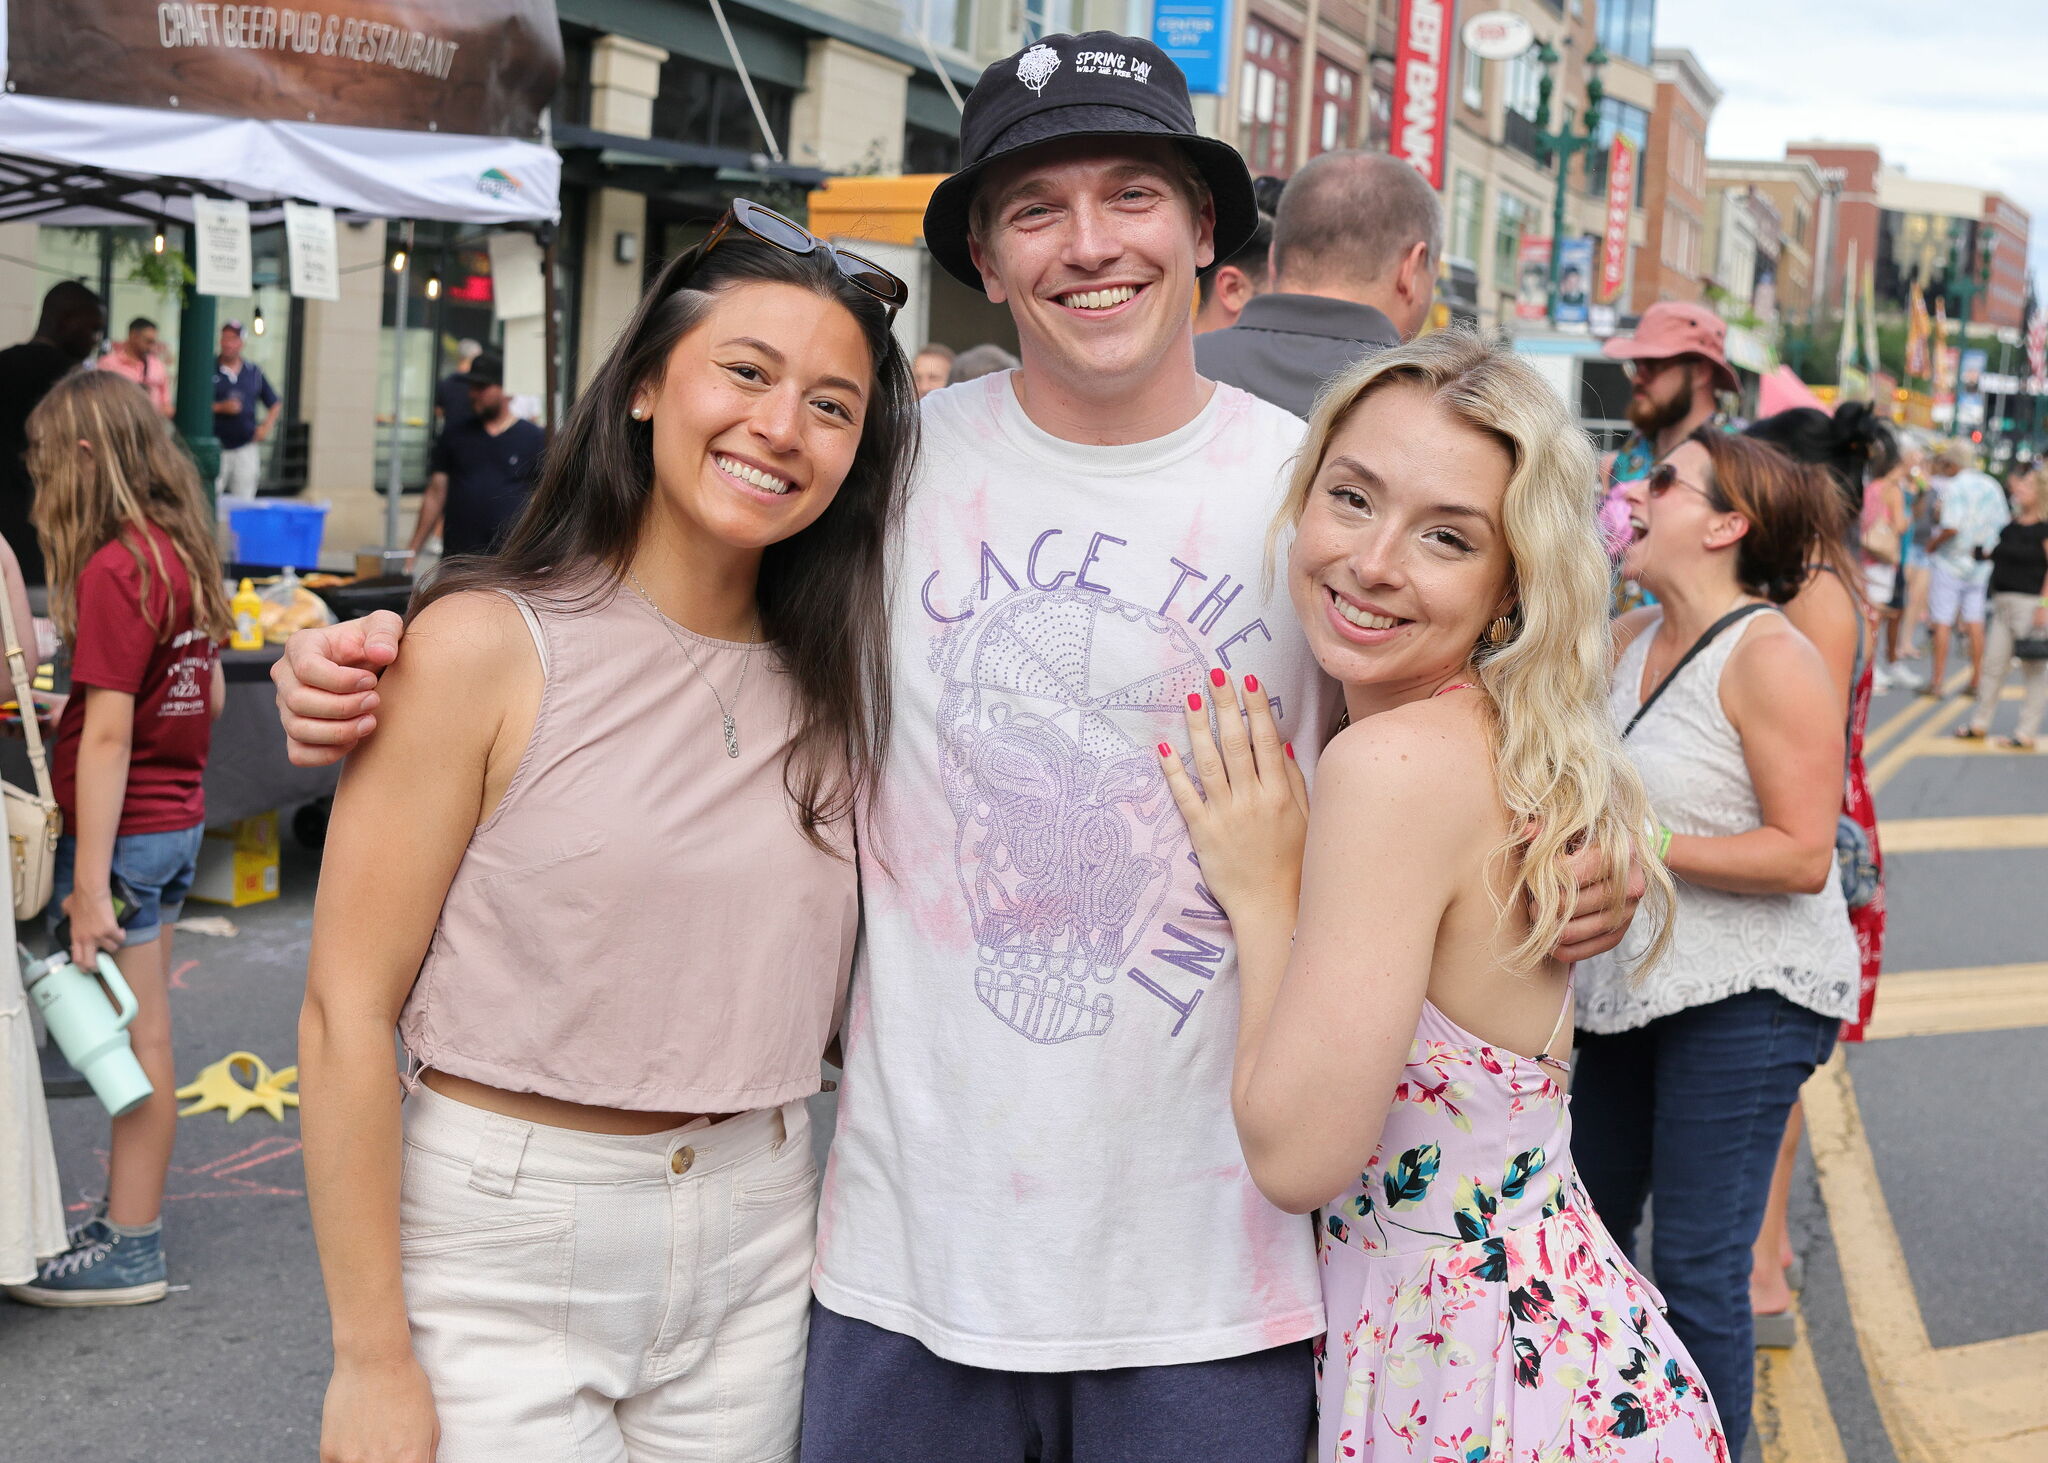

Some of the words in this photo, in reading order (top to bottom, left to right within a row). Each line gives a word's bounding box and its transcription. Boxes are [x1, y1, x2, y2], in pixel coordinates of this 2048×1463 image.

[1157, 16, 1214, 33] CENTER
[158, 3, 220, 48] CRAFT
[222, 4, 278, 50] BEER
[278, 8, 323, 54] PUB
[320, 14, 340, 57] &
[339, 17, 460, 81] RESTAURANT
[1167, 32, 1201, 47] CITY
[1075, 51, 1126, 69] SPRING
[1130, 57, 1152, 78] DAY
[1076, 65, 1097, 73] WILD
[1402, 58, 1440, 177] BANK
[921, 529, 1128, 624] CAGE
[1158, 557, 1273, 671] THE
